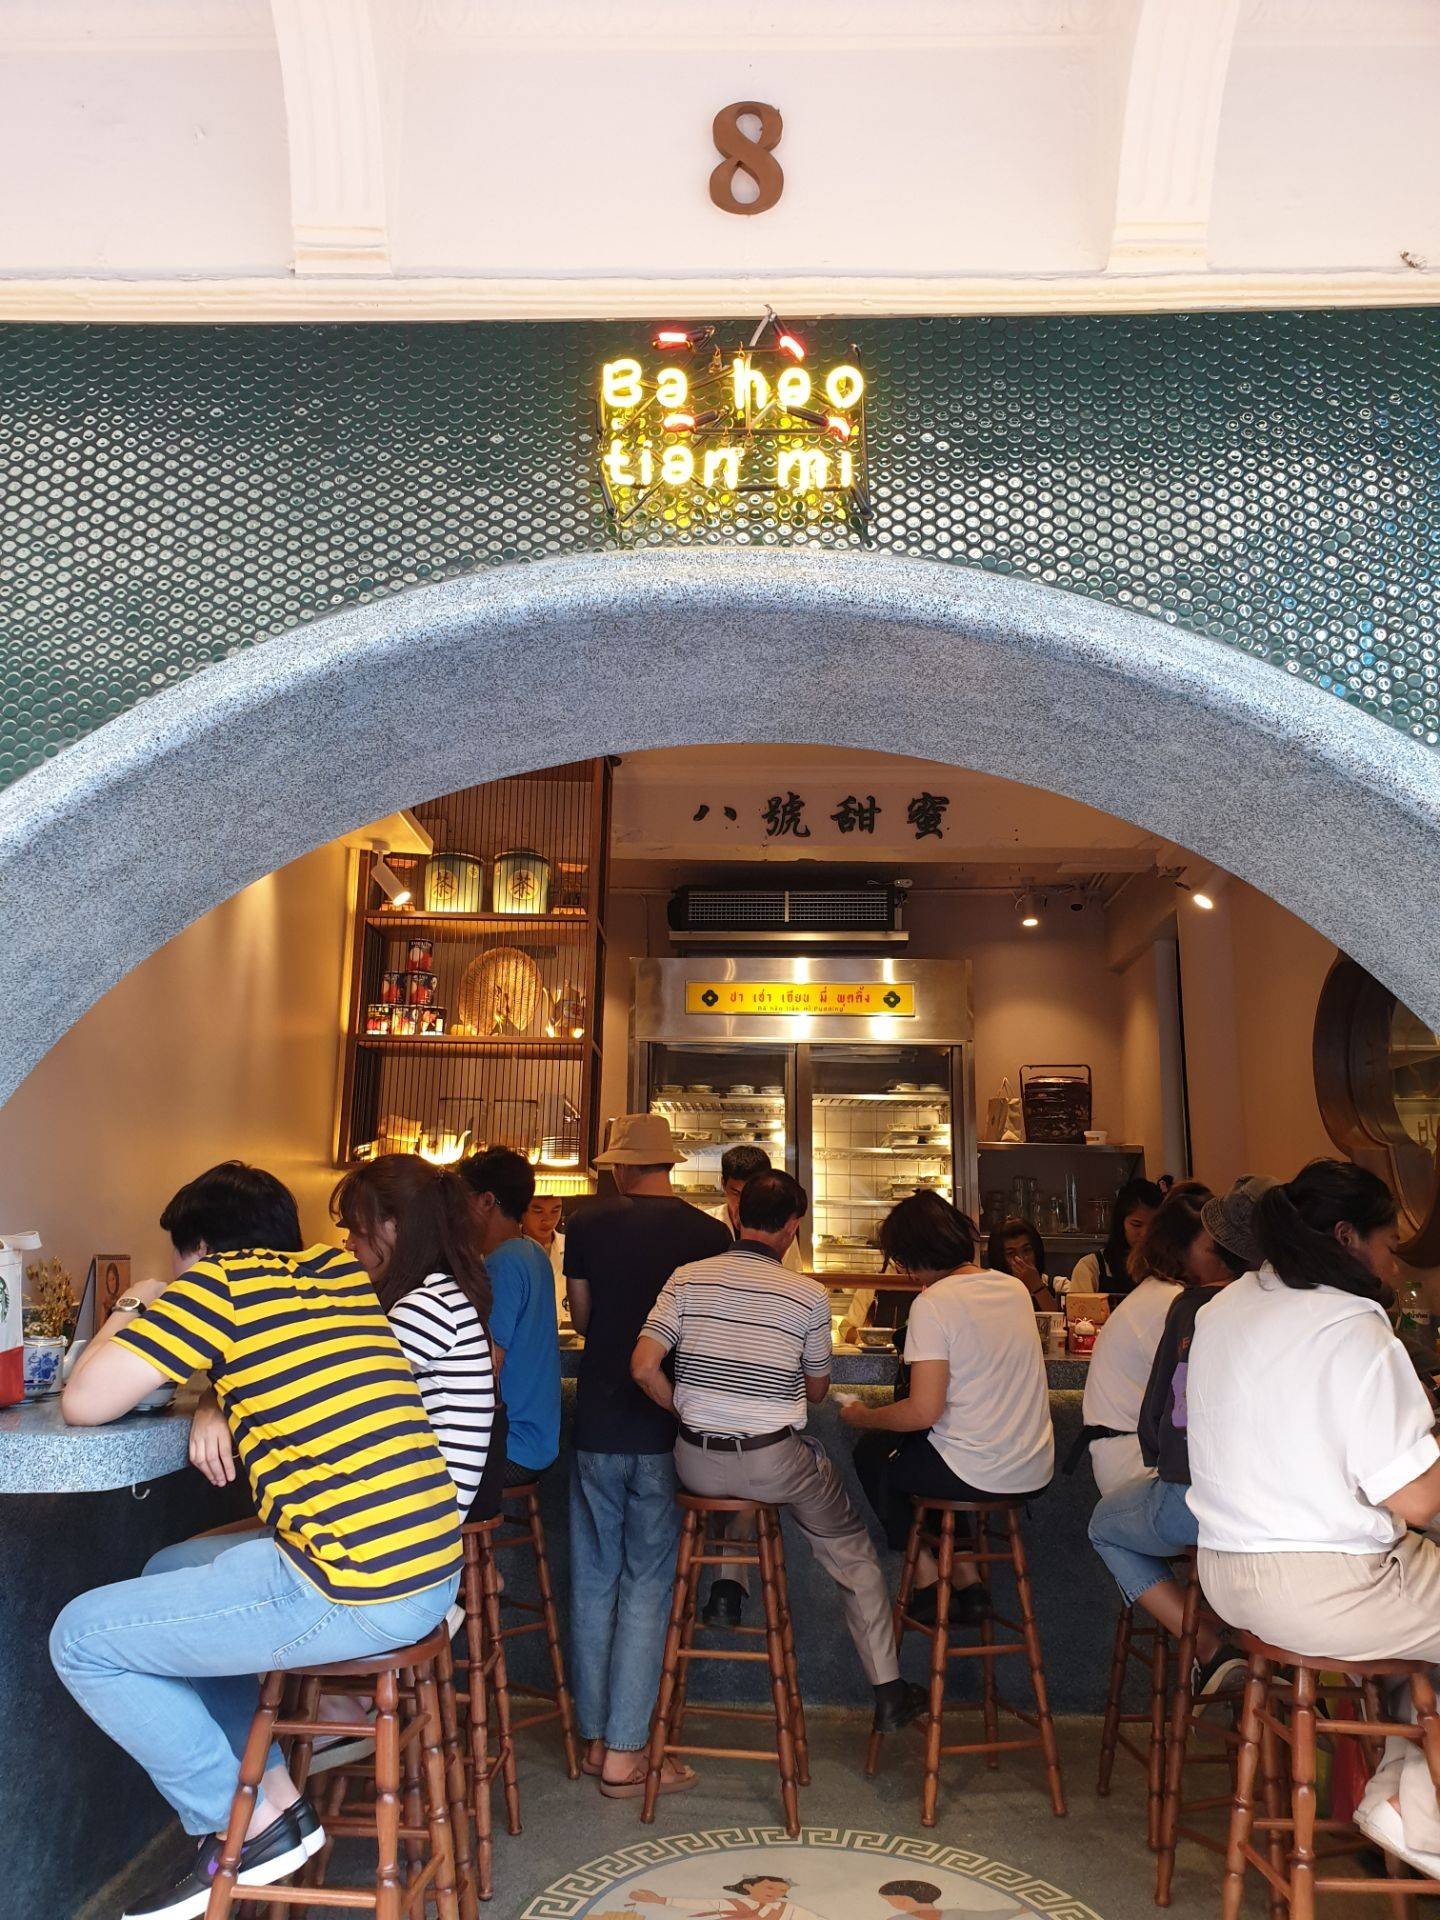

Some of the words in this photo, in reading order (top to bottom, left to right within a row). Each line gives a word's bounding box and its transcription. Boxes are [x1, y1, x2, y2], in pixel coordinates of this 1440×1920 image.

[709, 101, 784, 215] 8
[693, 791, 950, 840] 八號甜蜜
